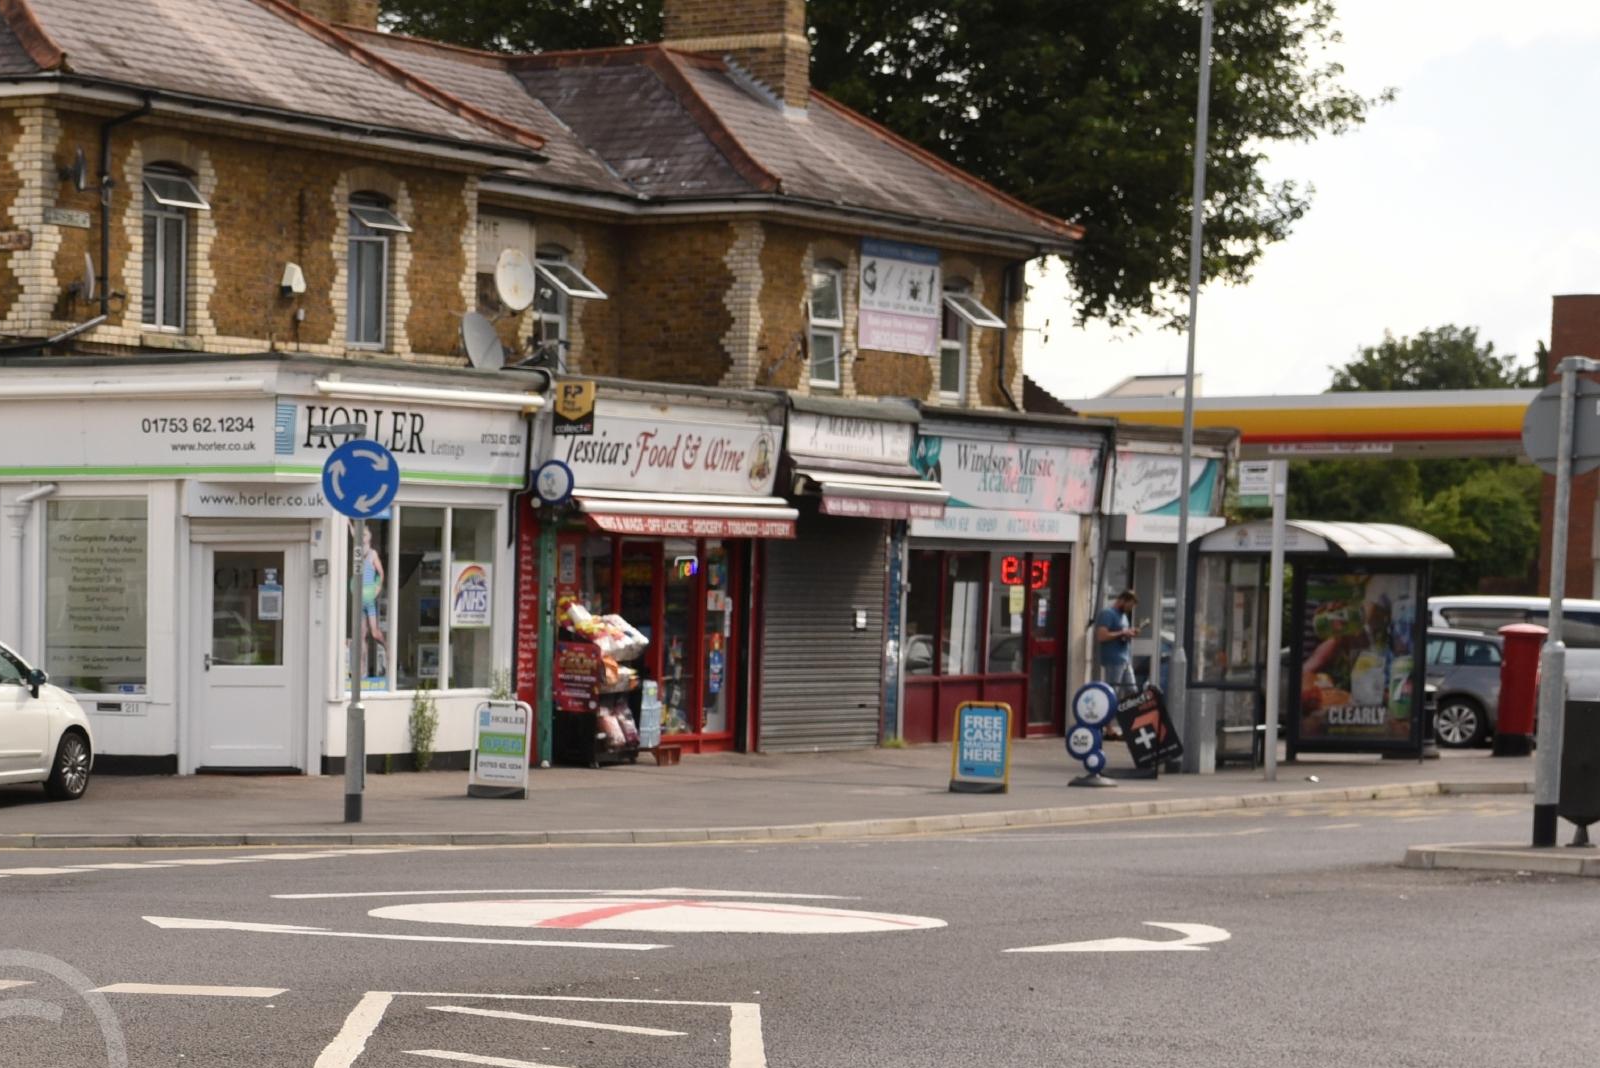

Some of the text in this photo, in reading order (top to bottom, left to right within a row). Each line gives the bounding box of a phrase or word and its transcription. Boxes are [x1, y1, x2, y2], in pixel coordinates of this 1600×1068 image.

[141, 416, 255, 433] 01753 62.1234
[171, 441, 256, 452] www.horler.co.uk
[431, 440, 465, 460] Lettings
[563, 428, 745, 477] Jessica's Food & Wine
[957, 443, 1055, 477] Windsor Music
[977, 472, 1035, 495] Academy
[200, 492, 324, 507] www.horler.co.uk
[462, 590, 487, 612] NHS
[124, 703, 139, 713] 211
[1328, 706, 1386, 724] CLEARLY
[964, 715, 1002, 728] FREE
[964, 728, 1002, 742] CASH
[483, 736, 522, 753] OPEN
[963, 749, 1002, 763] HERE
